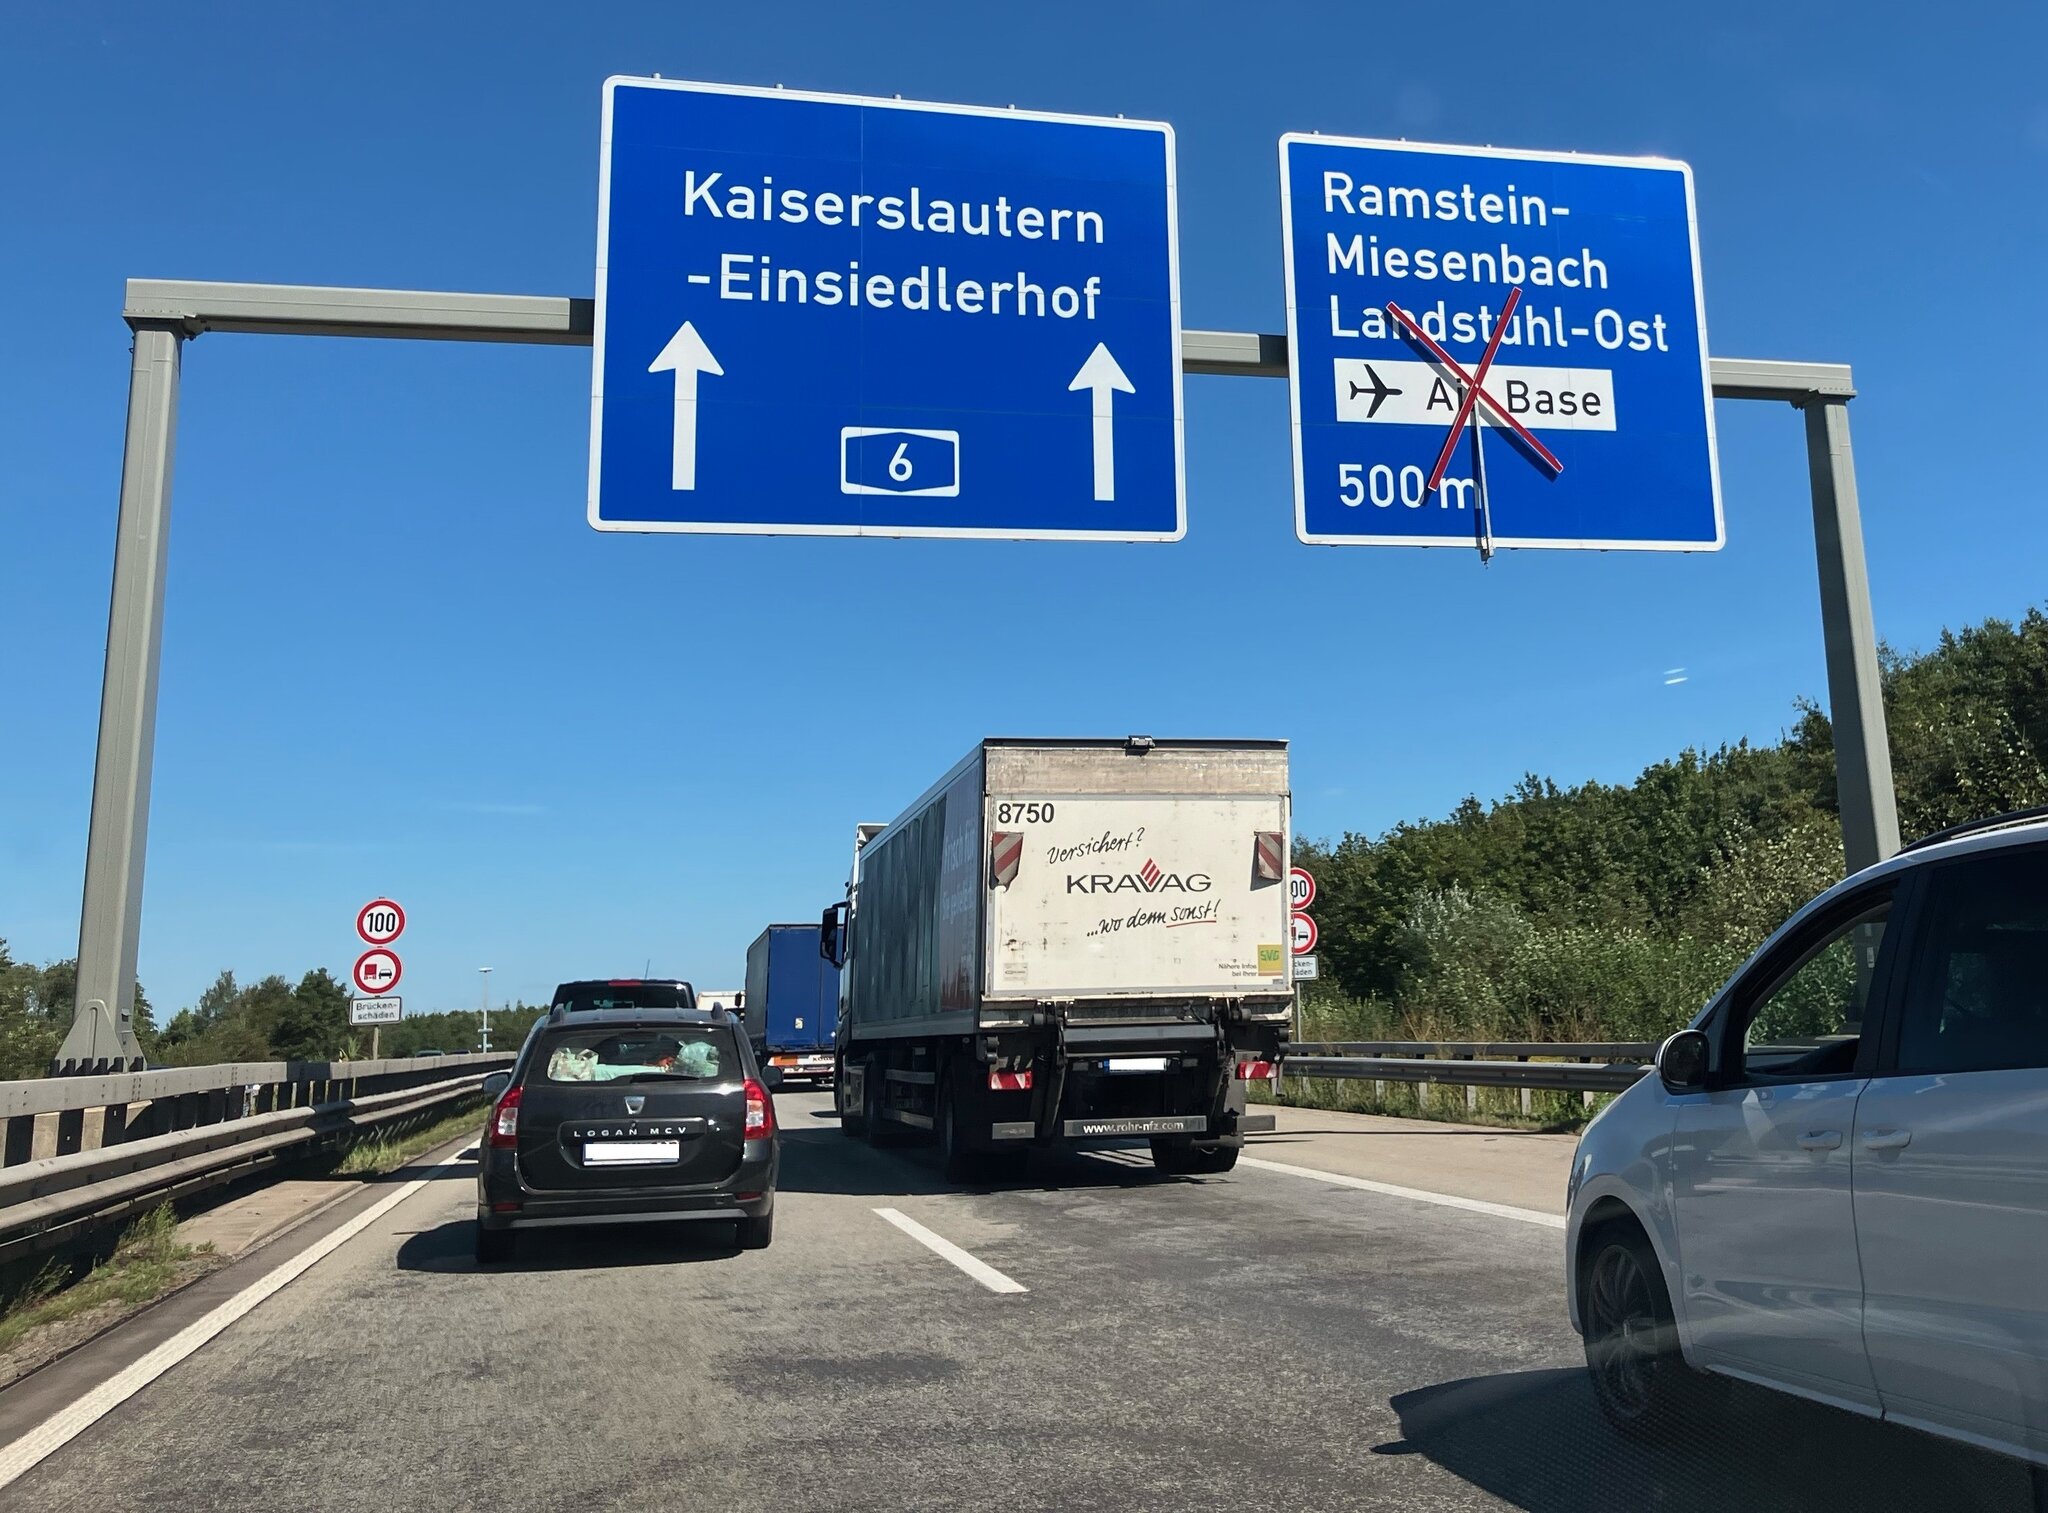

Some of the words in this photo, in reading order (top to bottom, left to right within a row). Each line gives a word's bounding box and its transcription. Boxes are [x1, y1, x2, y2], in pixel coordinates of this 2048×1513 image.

[684, 170, 1104, 243] Kaiserslautern
[1323, 171, 1570, 226] Ramstein-
[1327, 233, 1608, 289] Miesenbach
[687, 253, 1101, 320] -Einsiedlerhof
[1506, 379, 1601, 416] Base
[888, 442, 913, 482] 6
[1339, 463, 1425, 508] 500
[1440, 477, 1482, 509] m
[998, 803, 1055, 823] 8750
[1066, 873, 1212, 894] KRAVAG
[1291, 880, 1307, 897] 00
[367, 912, 396, 932] 100
[1126, 907, 1166, 928] denn
[1170, 898, 1221, 921] sonst!
[1260, 950, 1279, 961] SVG
[356, 1002, 397, 1011] Brücken-
[358, 1011, 395, 1020] schäden
[573, 1128, 638, 1138] LOGAN
[649, 1126, 687, 1135] MCV
[1083, 1120, 1184, 1134] www.rohr-nfz.com
